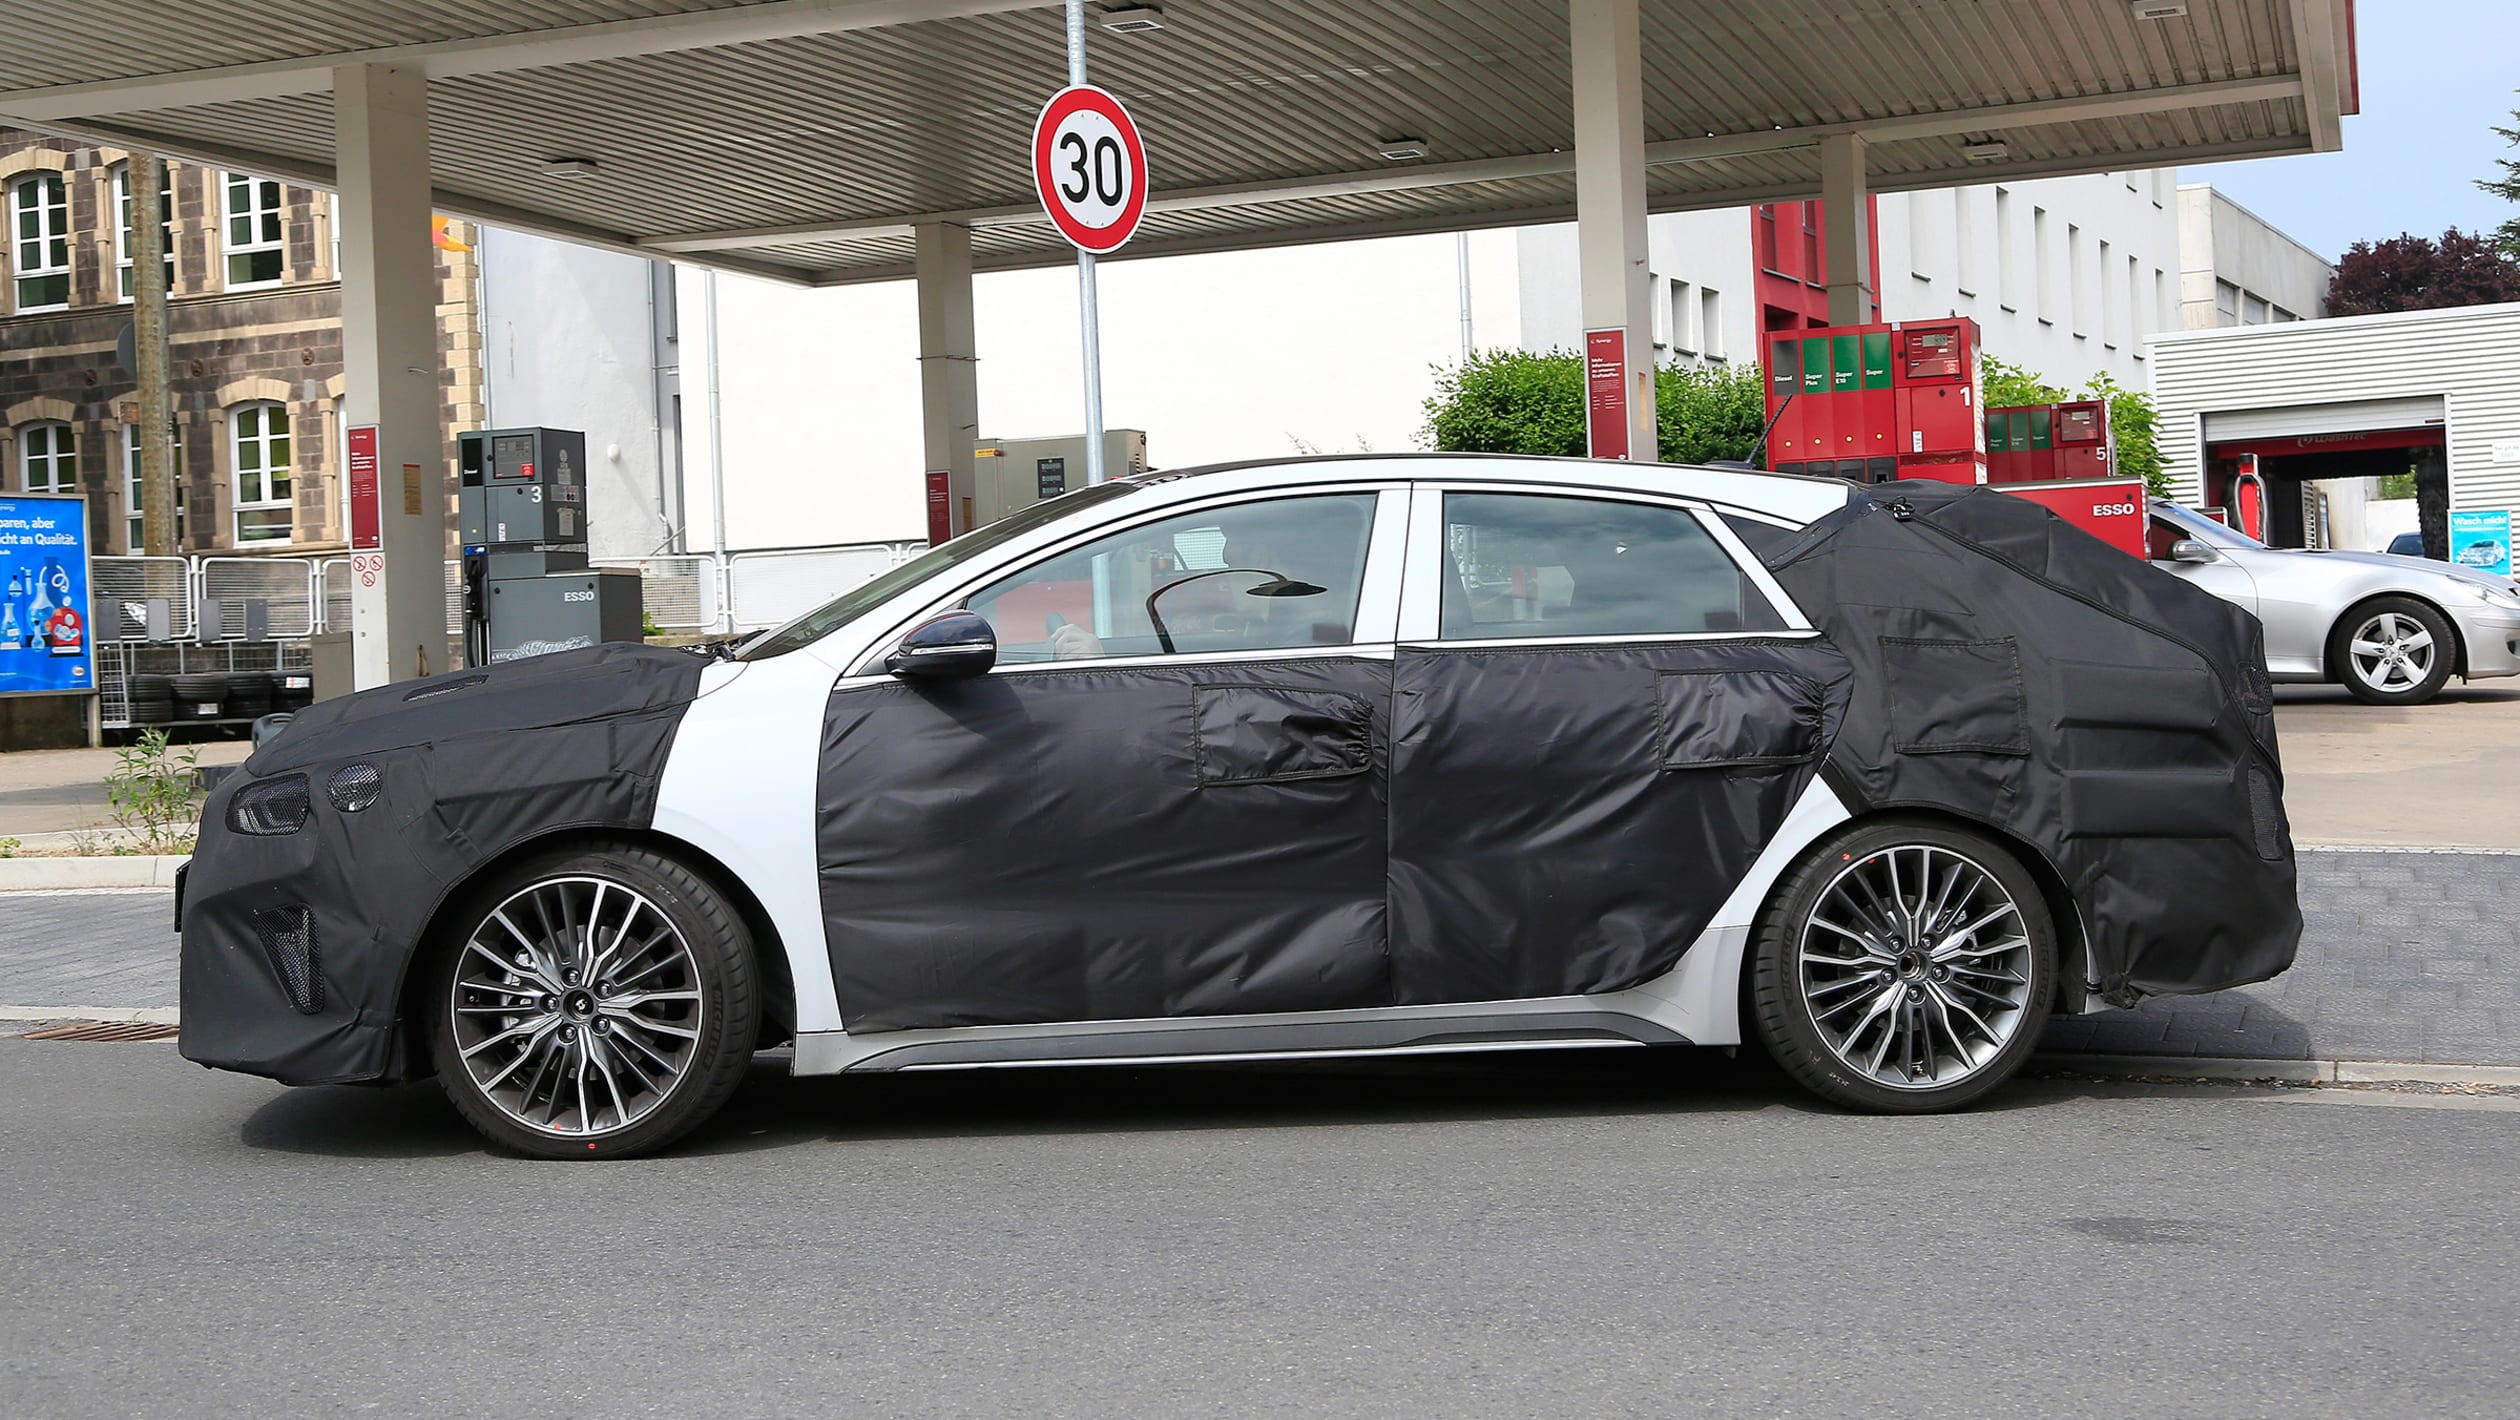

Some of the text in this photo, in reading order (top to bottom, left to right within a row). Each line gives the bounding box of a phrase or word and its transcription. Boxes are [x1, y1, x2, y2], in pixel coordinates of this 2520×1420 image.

[1059, 132, 1123, 207] 30
[1959, 386, 1971, 407] 1
[2095, 446, 2107, 461] 5
[530, 485, 543, 503] 3
[2092, 503, 2136, 517] ESSO
[31, 516, 56, 529] aber
[2453, 515, 2482, 526] Wasch
[20, 535, 34, 545] an
[564, 591, 595, 602] ESSO
